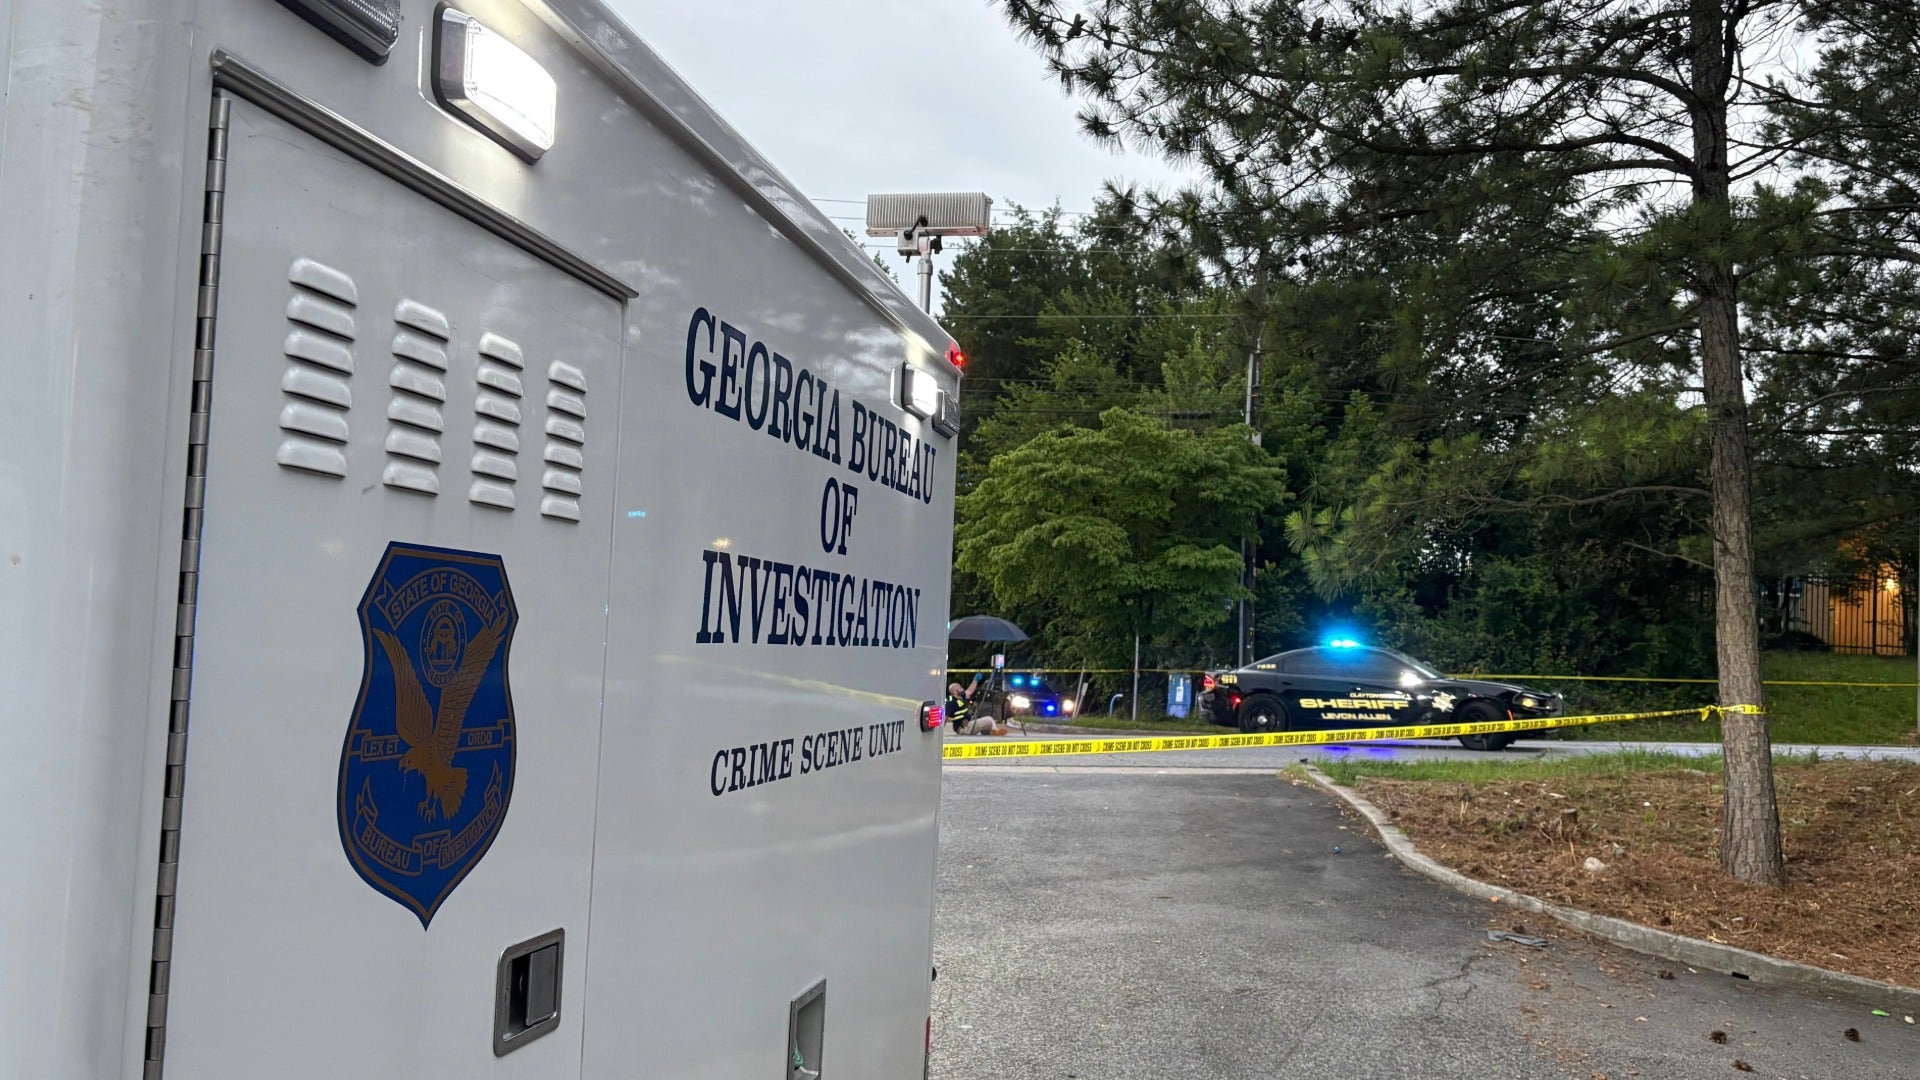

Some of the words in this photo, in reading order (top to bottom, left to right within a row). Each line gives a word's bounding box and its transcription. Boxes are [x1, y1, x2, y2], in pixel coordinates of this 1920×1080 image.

[685, 307, 841, 466] GEORGIA
[848, 400, 936, 505] BUREAU
[821, 477, 858, 556] OF
[391, 579, 428, 620] STATE
[431, 573, 447, 592] OF
[451, 574, 494, 624] GEORGIA
[696, 550, 920, 649] INVESTIGATION
[1221, 674, 1238, 684] 911
[1299, 699, 1409, 709] SHERIFF
[1358, 713, 1392, 721] ALLEN
[364, 740, 384, 756] LEX
[386, 739, 399, 753] ET
[467, 731, 493, 746] ORDO
[949, 747, 963, 757] CROSS
[974, 746, 987, 756] CRIME
[988, 746, 1001, 756] SCENE
[1002, 746, 1007, 755] DO
[1008, 745, 1016, 755] NOT
[1016, 745, 1029, 755] CROSS
[1040, 744, 1052, 754] CRIME
[1053, 744, 1065, 753] SCENE
[1080, 743, 1092, 752] CROSS
[1103, 742, 1114, 751] CRIME
[1115, 742, 1126, 751] SCENE
[1140, 741, 1152, 750] CROSS
[710, 738, 794, 797] CRIME
[800, 730, 863, 775] SCENE
[869, 720, 905, 756] UNIT
[361, 825, 411, 869] BUREAU
[424, 839, 439, 856] OF
[441, 798, 499, 865] INVESTIGATION
